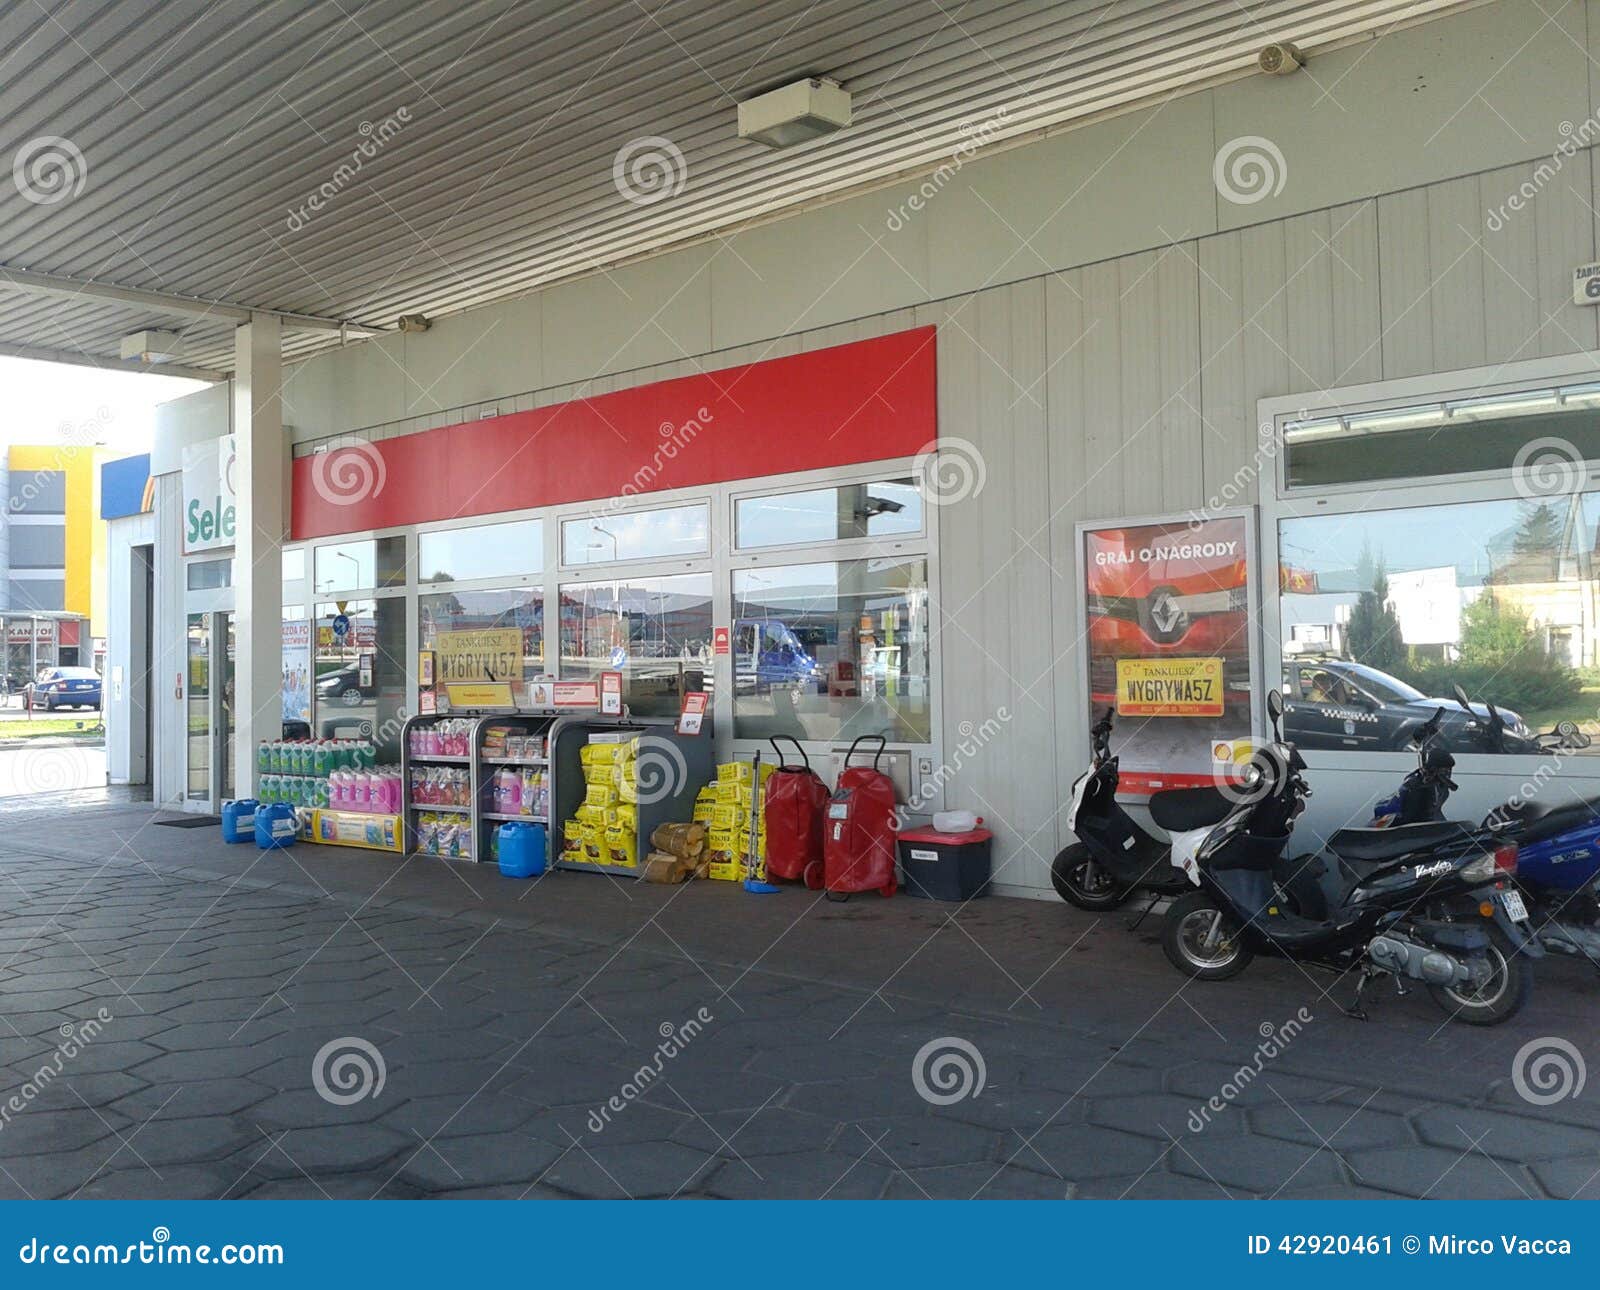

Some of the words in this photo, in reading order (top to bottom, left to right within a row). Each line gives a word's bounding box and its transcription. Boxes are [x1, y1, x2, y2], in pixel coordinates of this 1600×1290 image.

[1095, 550, 1135, 565] GRAJ
[1139, 548, 1152, 562] O
[1155, 541, 1238, 561] NAGRODY
[1143, 666, 1195, 677] TANKUJESZ
